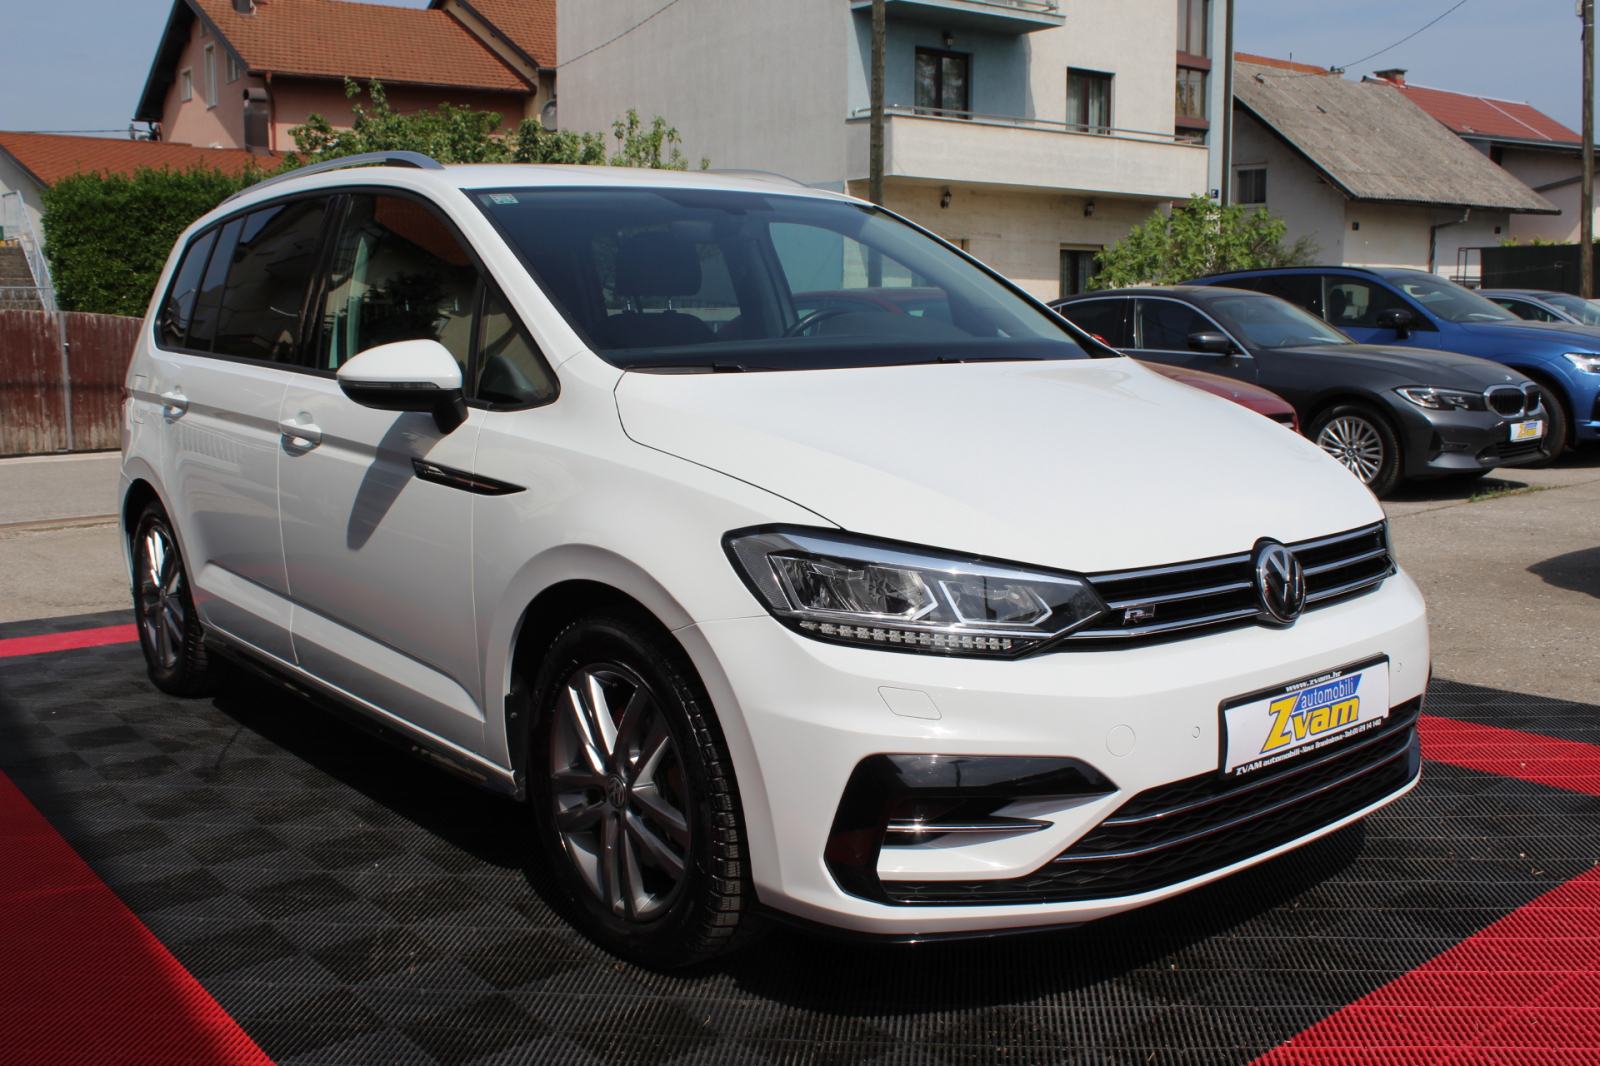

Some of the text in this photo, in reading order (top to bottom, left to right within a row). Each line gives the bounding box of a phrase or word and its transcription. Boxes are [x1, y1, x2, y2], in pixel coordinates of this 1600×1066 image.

[1301, 678, 1354, 709] automobili
[1260, 692, 1360, 754] Zvam
[1235, 761, 1263, 776] ZVAM
